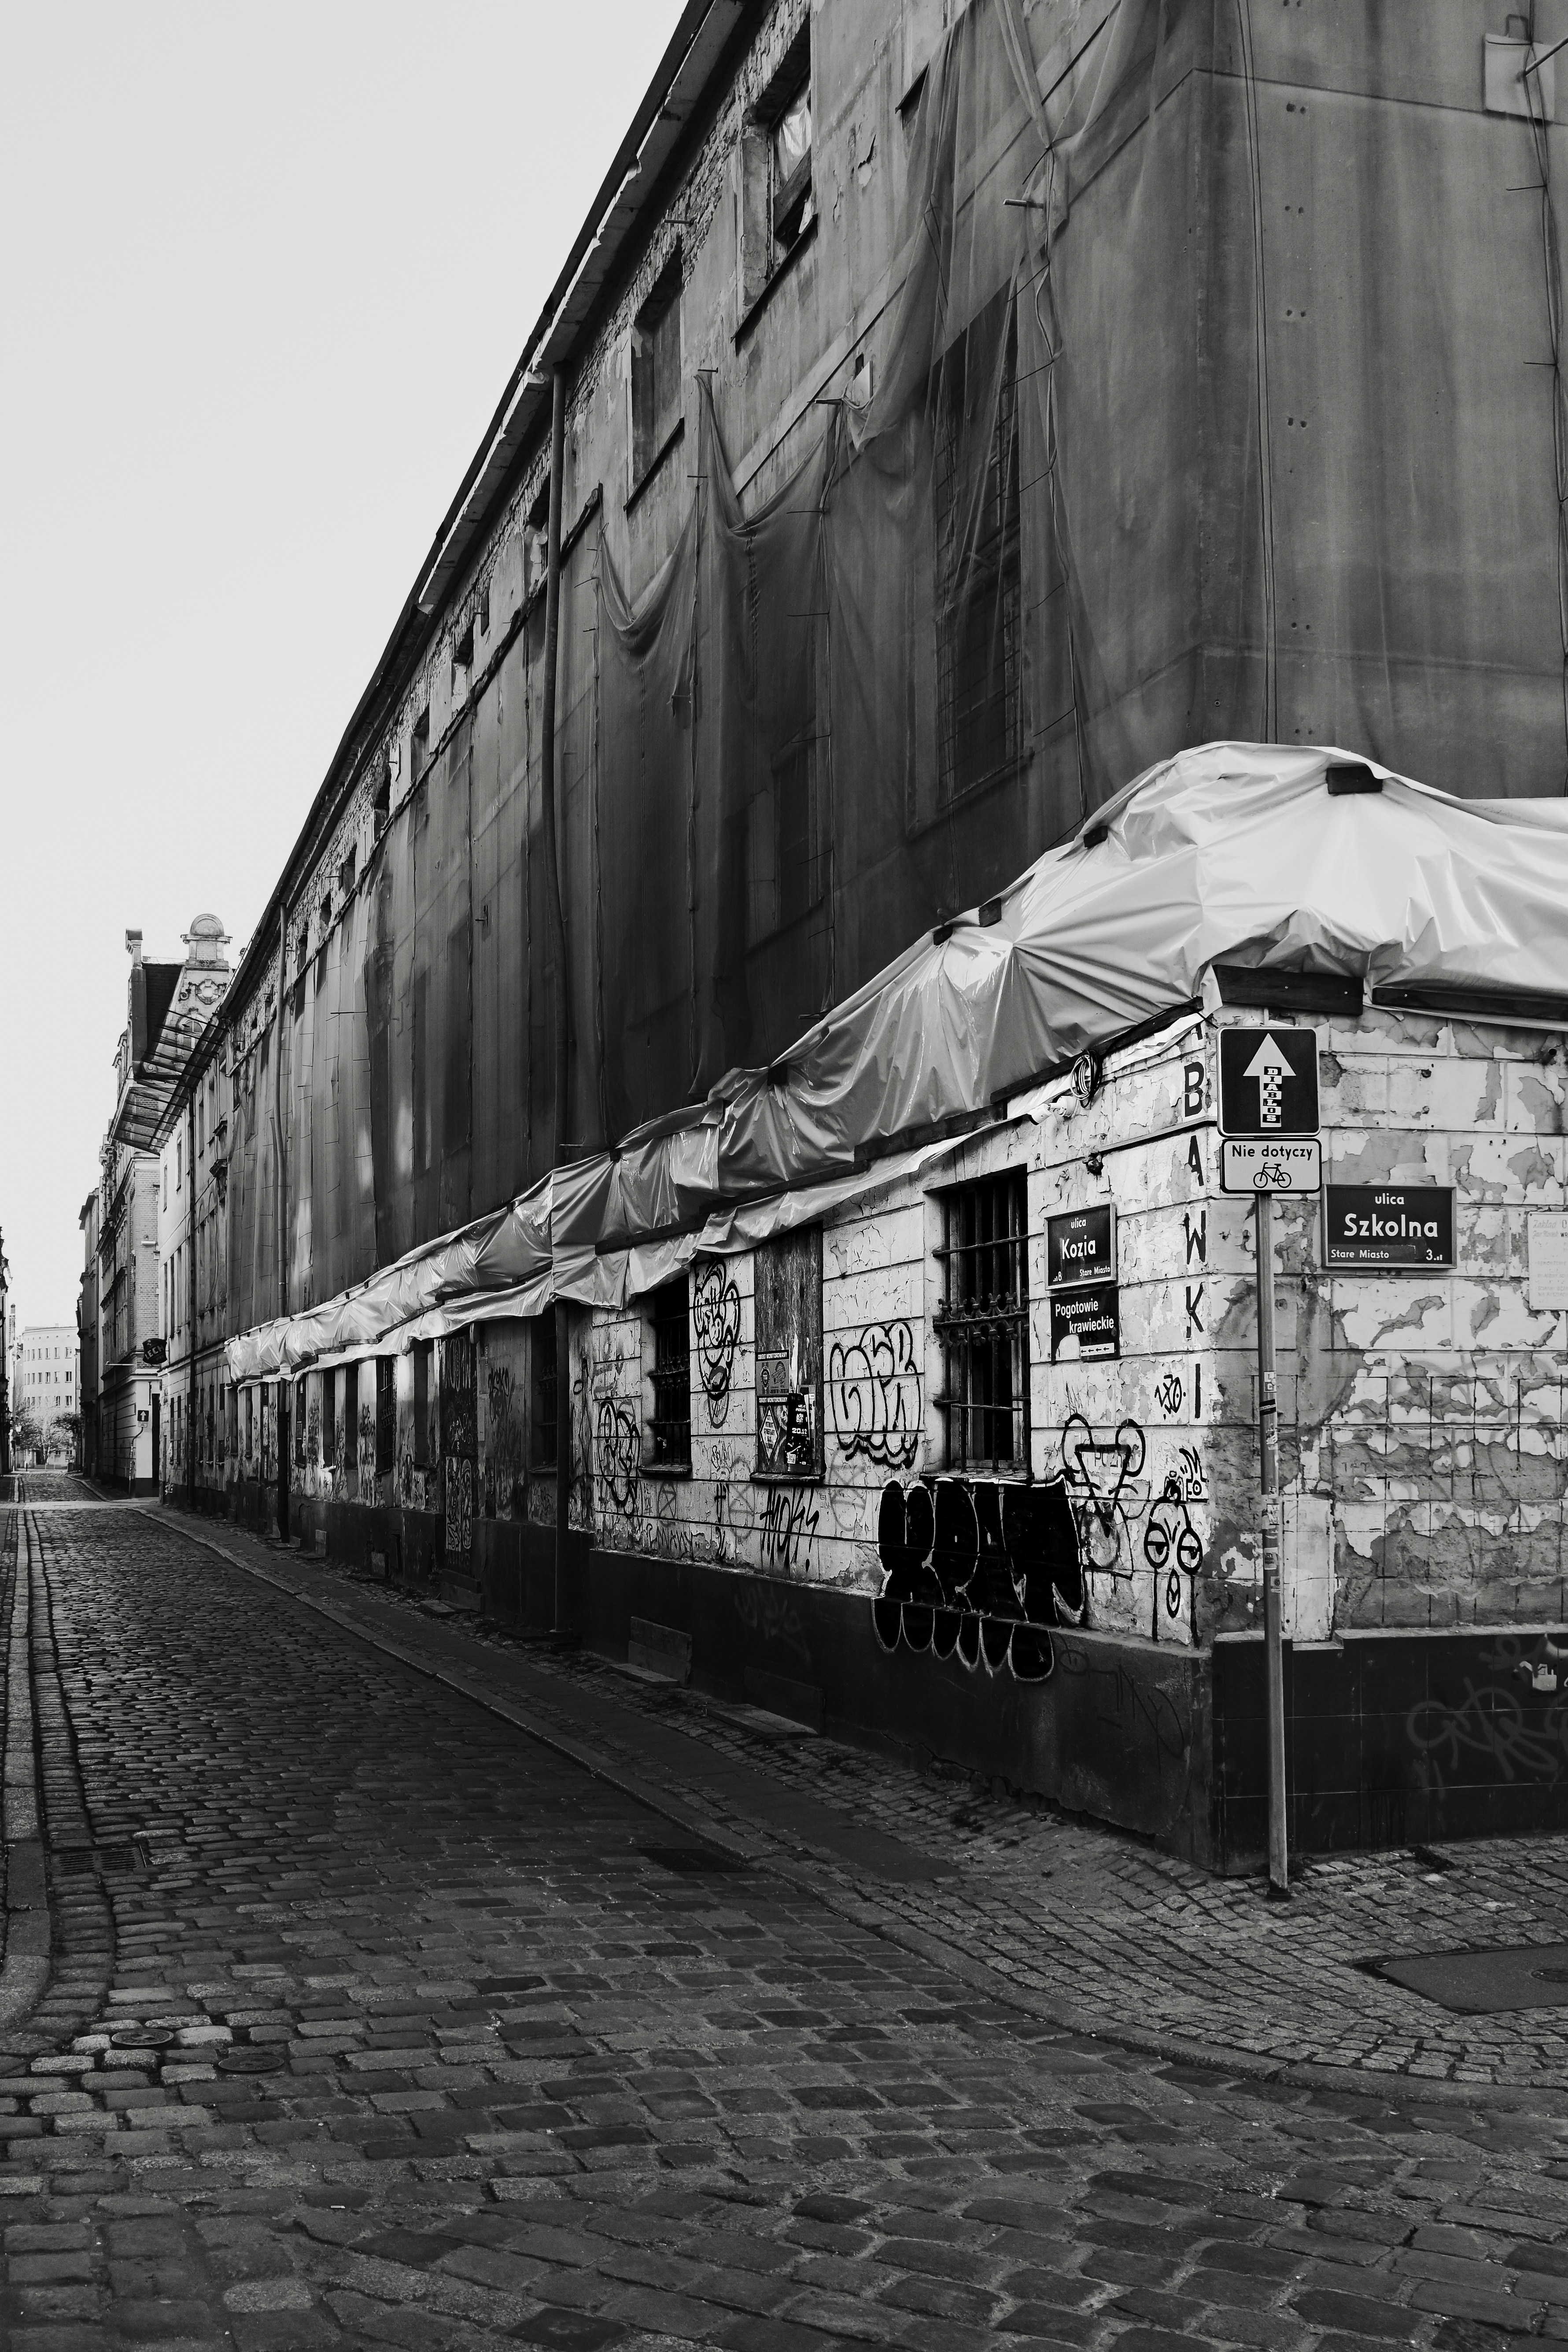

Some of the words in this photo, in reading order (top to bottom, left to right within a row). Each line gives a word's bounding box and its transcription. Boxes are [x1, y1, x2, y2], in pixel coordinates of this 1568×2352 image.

[1266, 1068, 1278, 1122] DIABLOS
[1232, 1145, 1255, 1158] Nie
[1261, 1145, 1313, 1161] dotyczy
[1375, 1192, 1405, 1205] ulica
[1070, 1217, 1087, 1229] ulica
[1343, 1213, 1439, 1238] Szkolna
[1062, 1235, 1096, 1260] Kozia
[1331, 1249, 1355, 1259] Stare
[1359, 1249, 1390, 1259] Miasto
[1079, 1268, 1092, 1277] Stare
[1094, 1265, 1111, 1275] Miasto
[1055, 1298, 1099, 1319] Pogotowie
[1069, 1315, 1114, 1334] krawieckie
[145, 1345, 164, 1360] LECH
